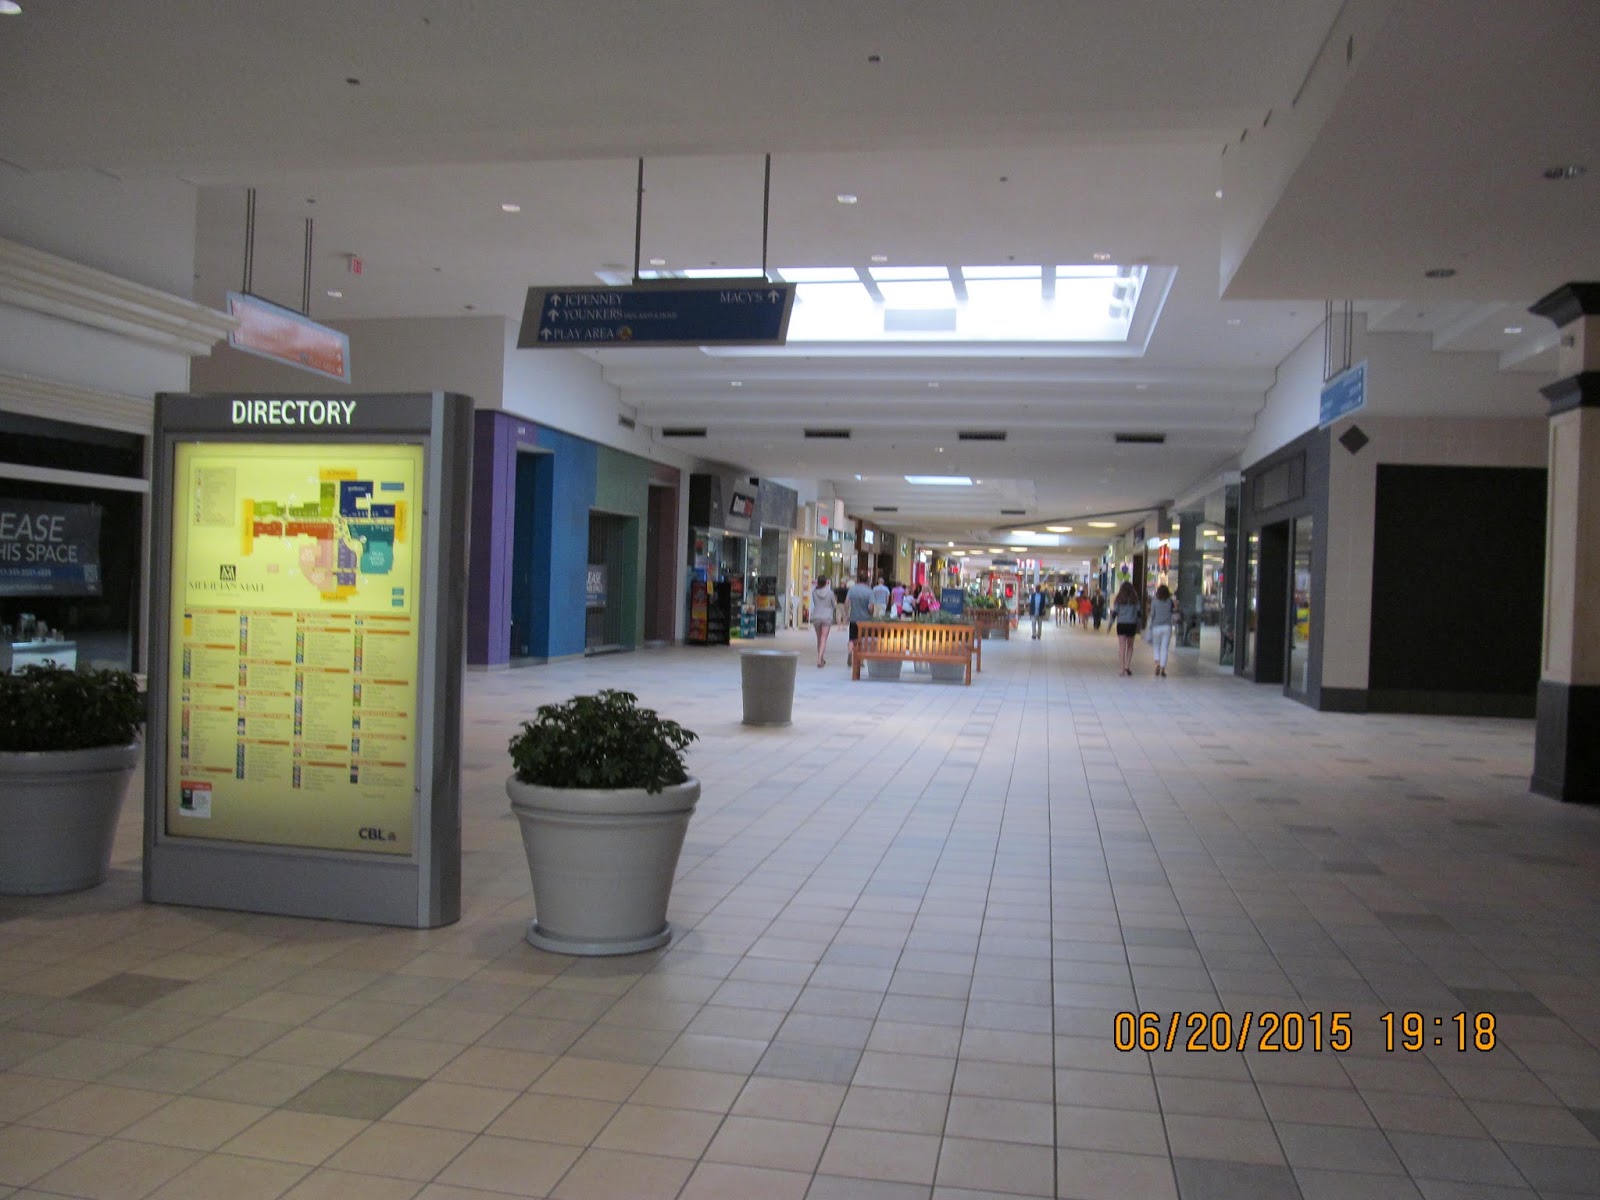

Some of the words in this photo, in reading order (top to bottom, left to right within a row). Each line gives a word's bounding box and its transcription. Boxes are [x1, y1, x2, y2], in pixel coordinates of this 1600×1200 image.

[564, 293, 623, 306] JCPENNEY
[563, 308, 622, 320] YOUNKERS
[554, 327, 581, 340] PLAY
[585, 327, 614, 340] AREA
[231, 399, 357, 425] DIRECTORY
[25, 543, 78, 563] SPACE
[358, 827, 386, 841] CBL
